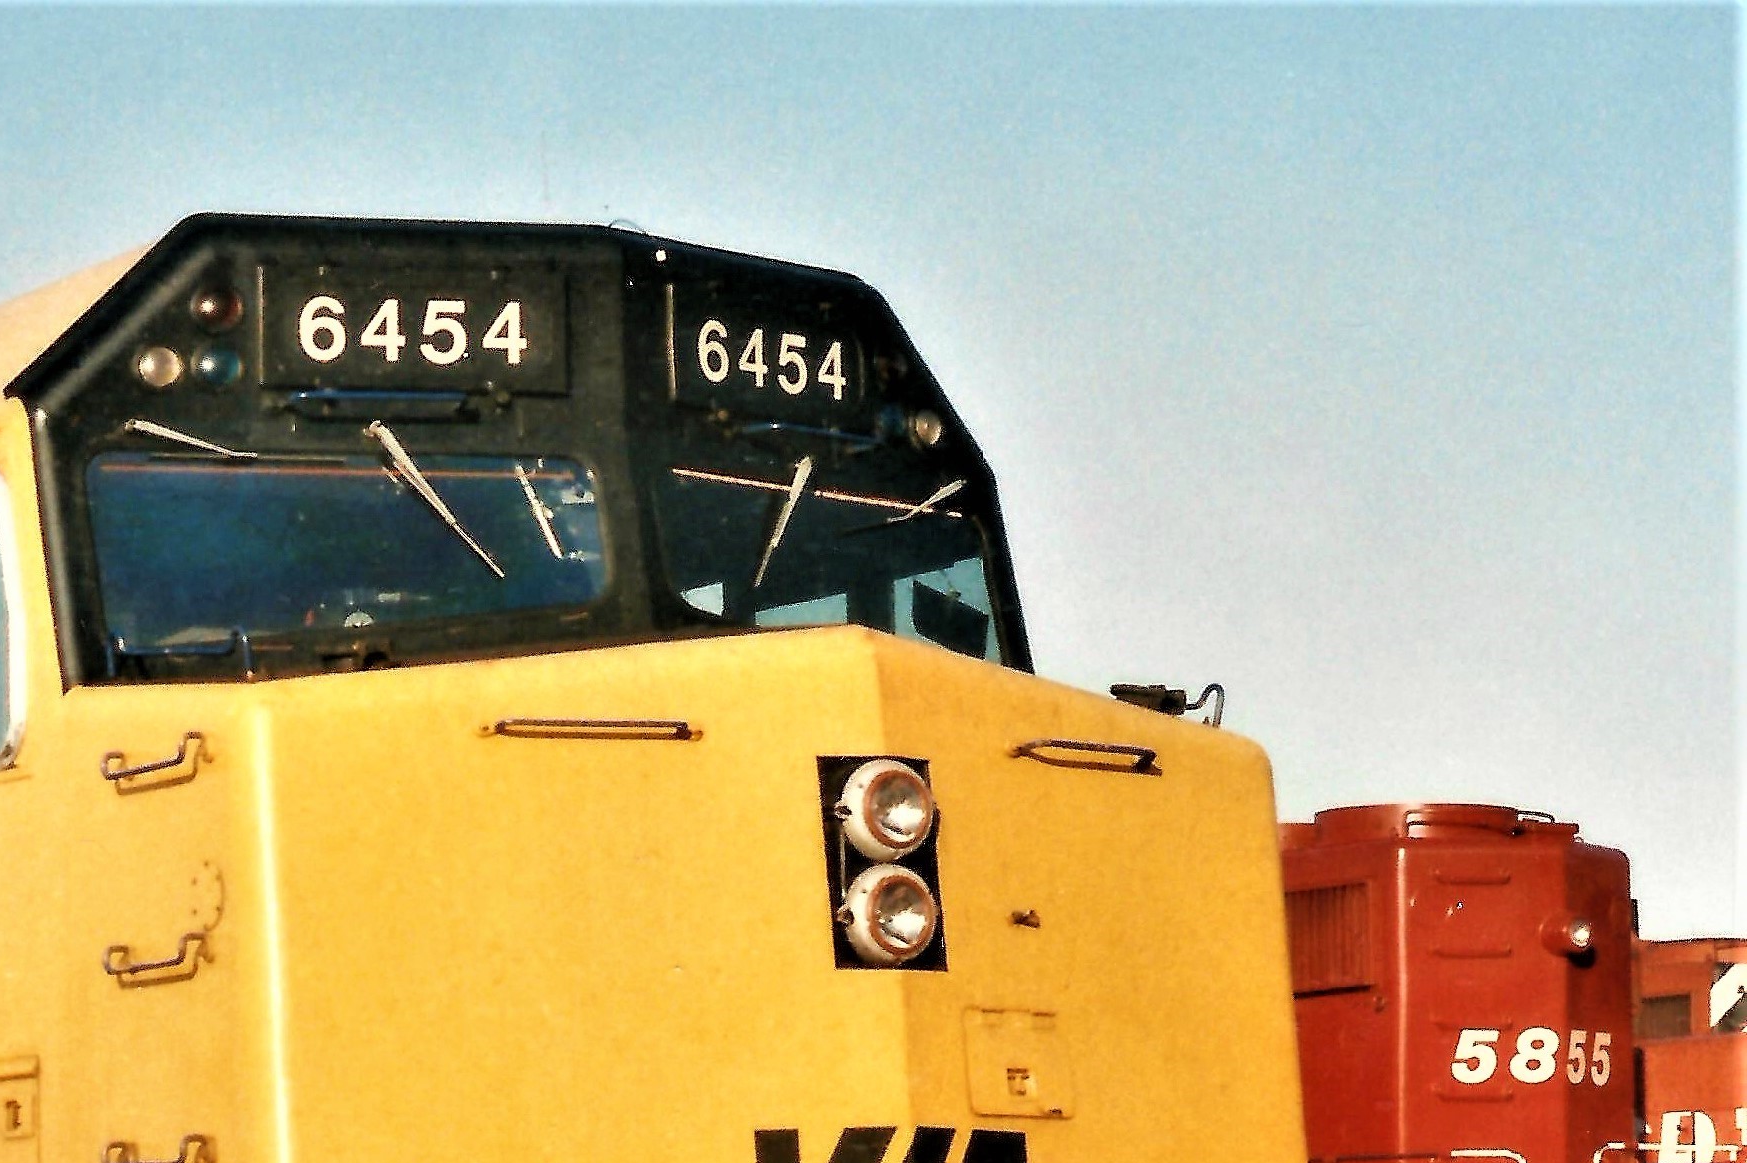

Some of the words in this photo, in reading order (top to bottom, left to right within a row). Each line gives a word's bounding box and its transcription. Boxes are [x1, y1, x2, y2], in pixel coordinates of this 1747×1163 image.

[297, 295, 529, 366] 6454
[696, 318, 847, 401] 6454
[1450, 1026, 1612, 1087] 5855
